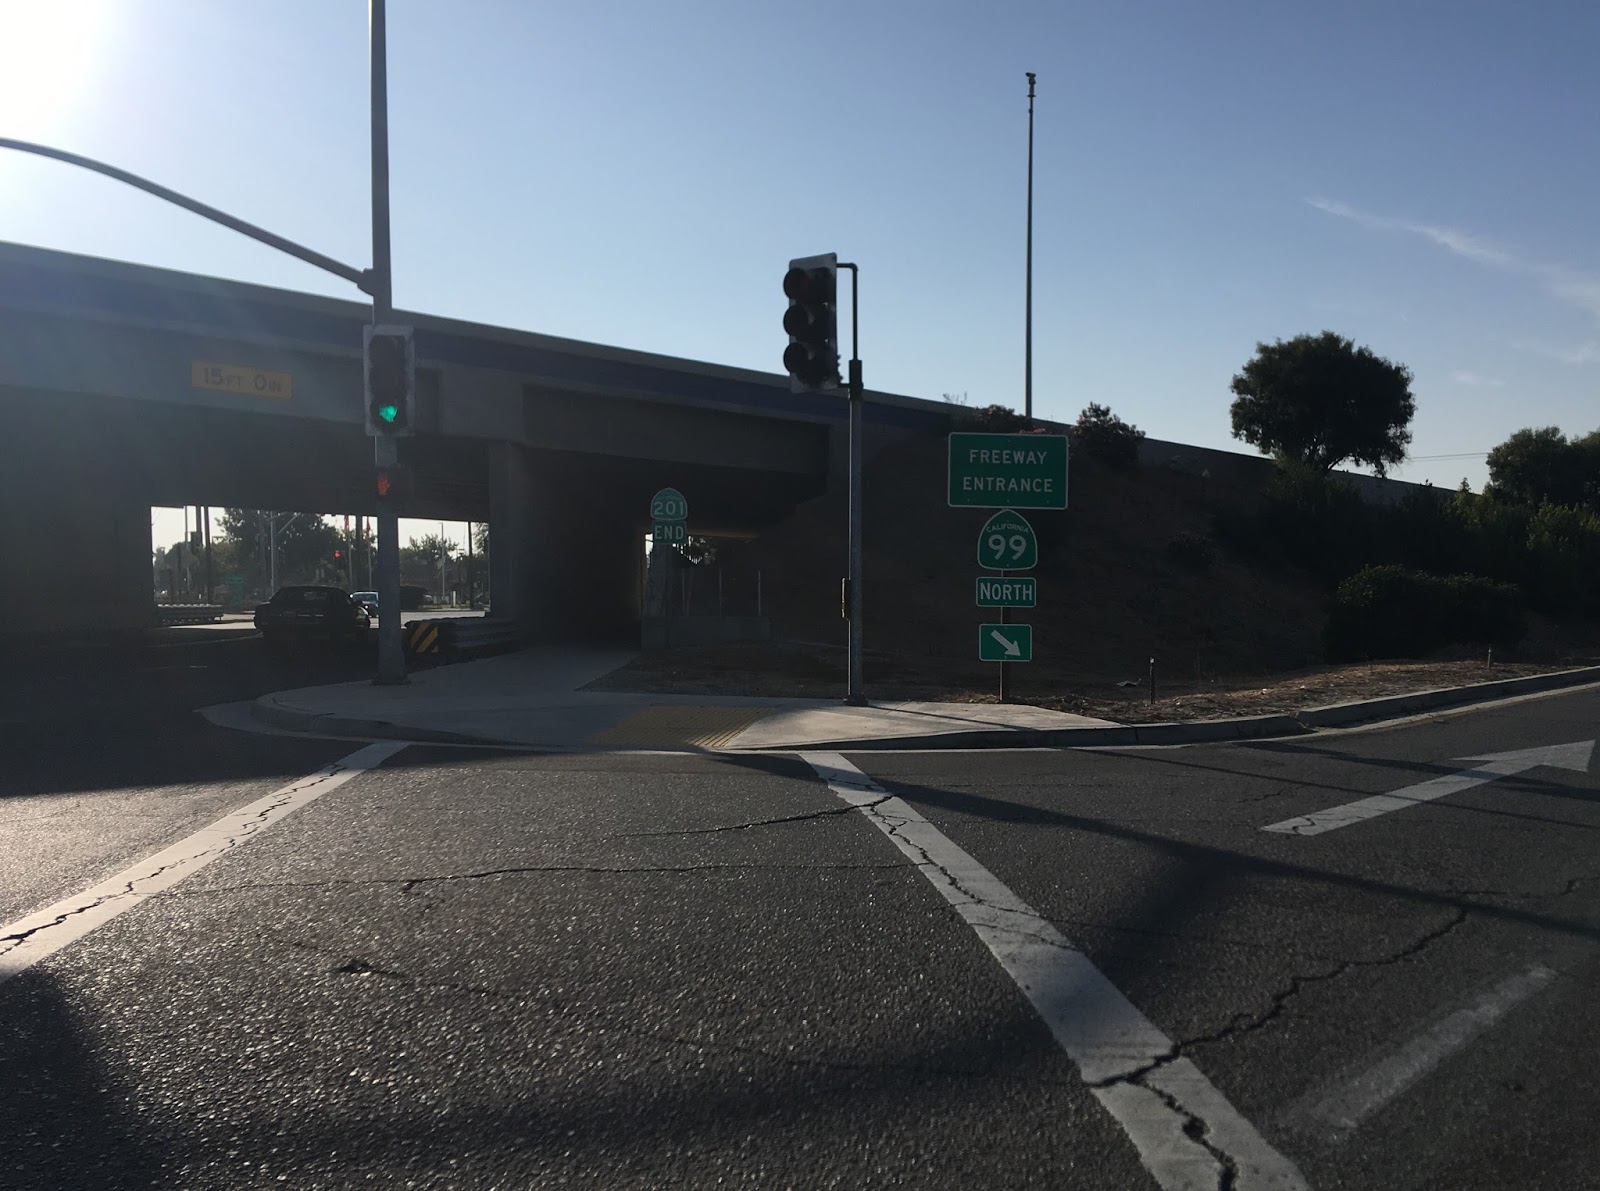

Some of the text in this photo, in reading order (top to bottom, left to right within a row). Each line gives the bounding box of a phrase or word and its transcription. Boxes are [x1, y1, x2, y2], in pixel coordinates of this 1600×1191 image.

[204, 367, 223, 385] 15
[224, 374, 241, 387] FT
[255, 374, 267, 391] 0
[969, 449, 1047, 464] FREEWAY
[963, 477, 1053, 492] ENTRANCE
[654, 501, 684, 515] 201
[655, 525, 684, 540] END
[986, 523, 1029, 534] CALIFORNIA
[988, 534, 1027, 560] 99
[980, 582, 1032, 600] NORTH
